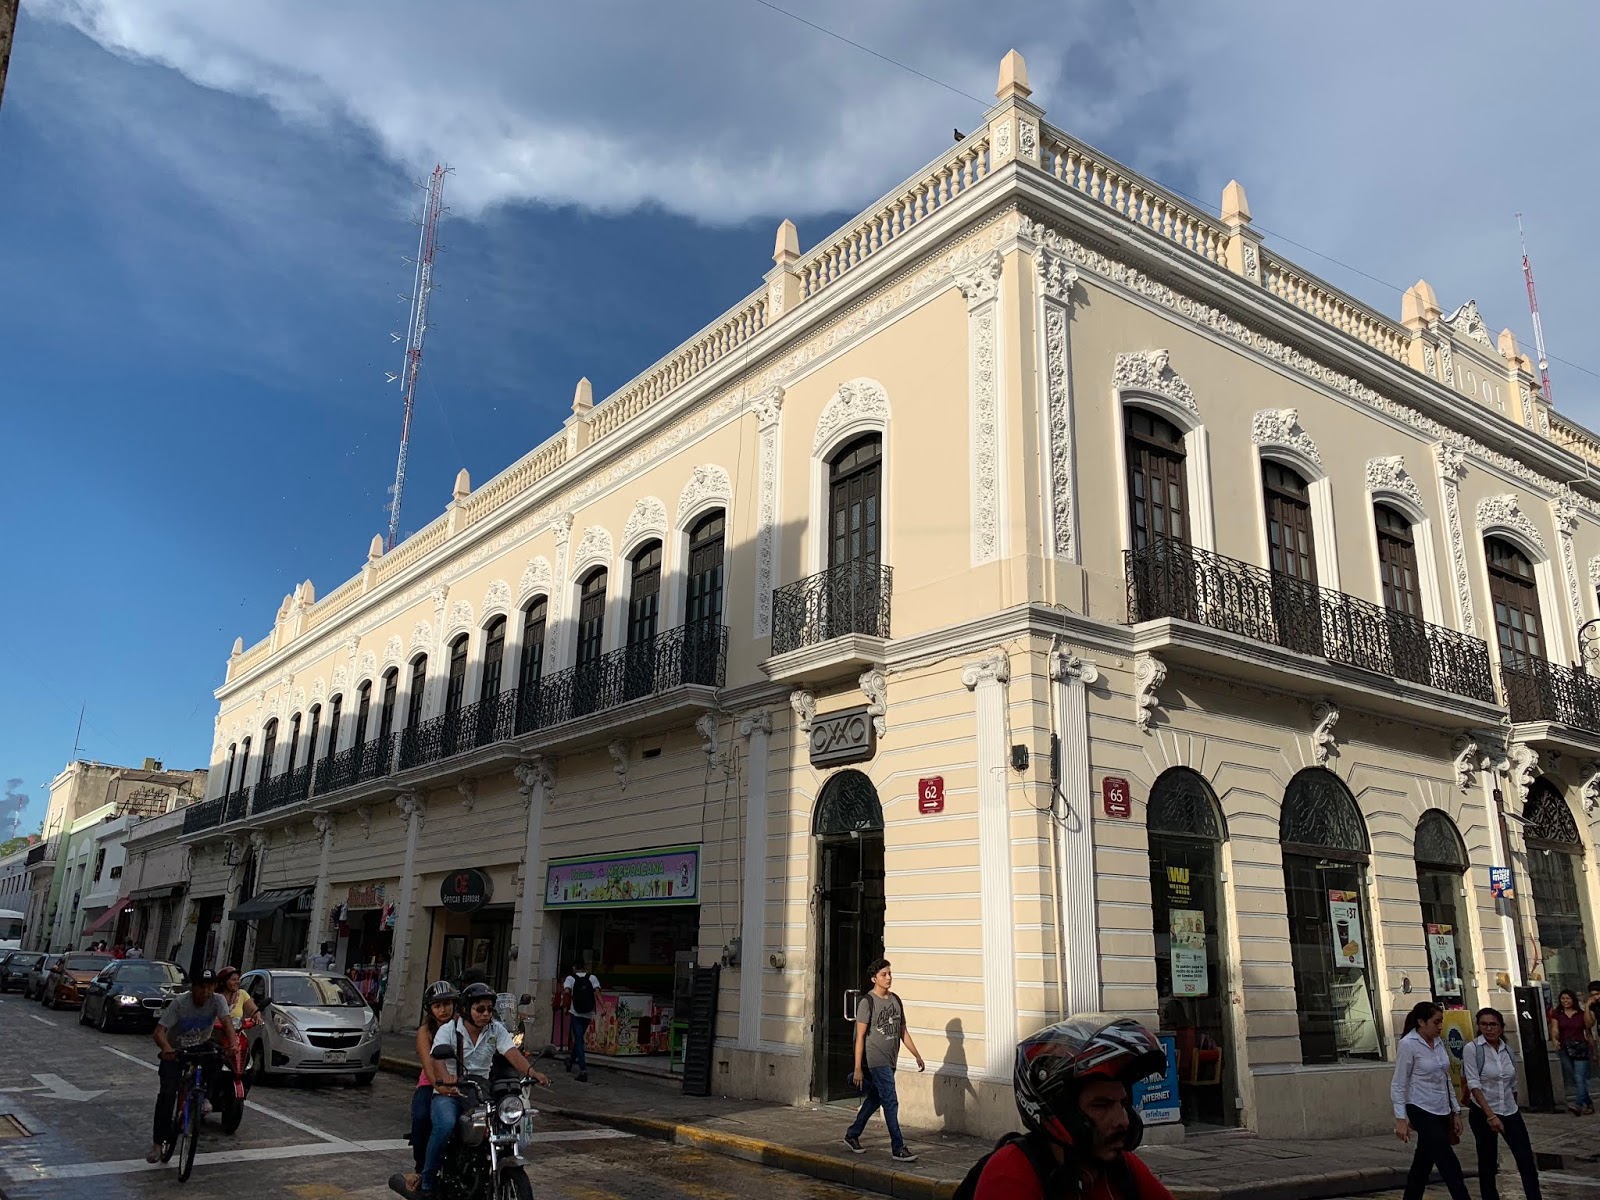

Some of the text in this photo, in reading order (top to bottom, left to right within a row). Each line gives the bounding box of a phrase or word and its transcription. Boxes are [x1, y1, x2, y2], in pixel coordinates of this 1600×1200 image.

[812, 715, 865, 753] OXXO
[924, 786, 938, 799] 62
[1110, 788, 1123, 802] 65
[607, 862, 665, 879] MICHOACANA
[1166, 866, 1190, 884] WU
